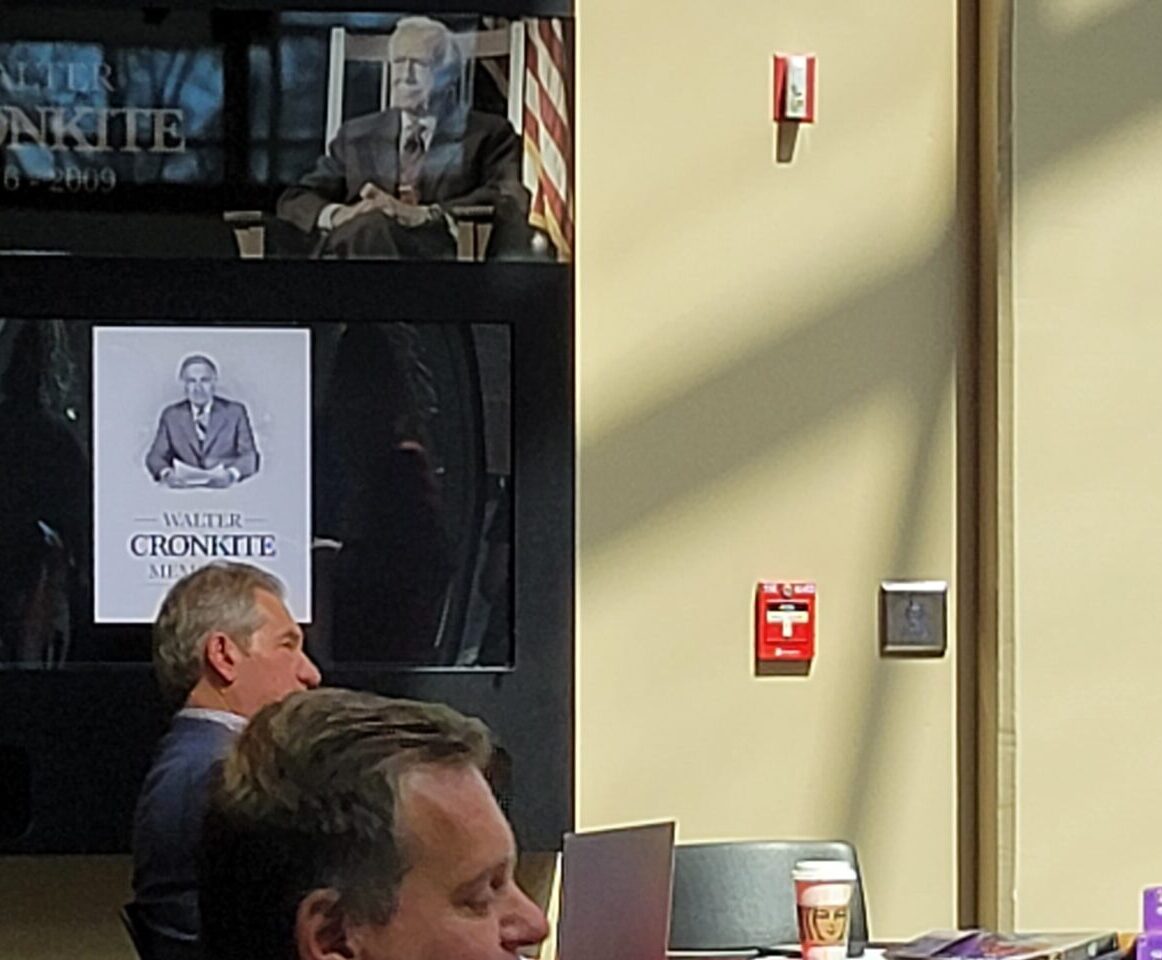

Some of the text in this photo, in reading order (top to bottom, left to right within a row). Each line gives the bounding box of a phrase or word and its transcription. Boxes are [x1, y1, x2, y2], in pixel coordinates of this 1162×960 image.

[49, 166, 117, 193] 2009
[163, 512, 242, 529] WALTER
[130, 534, 277, 557] CRONKITE
